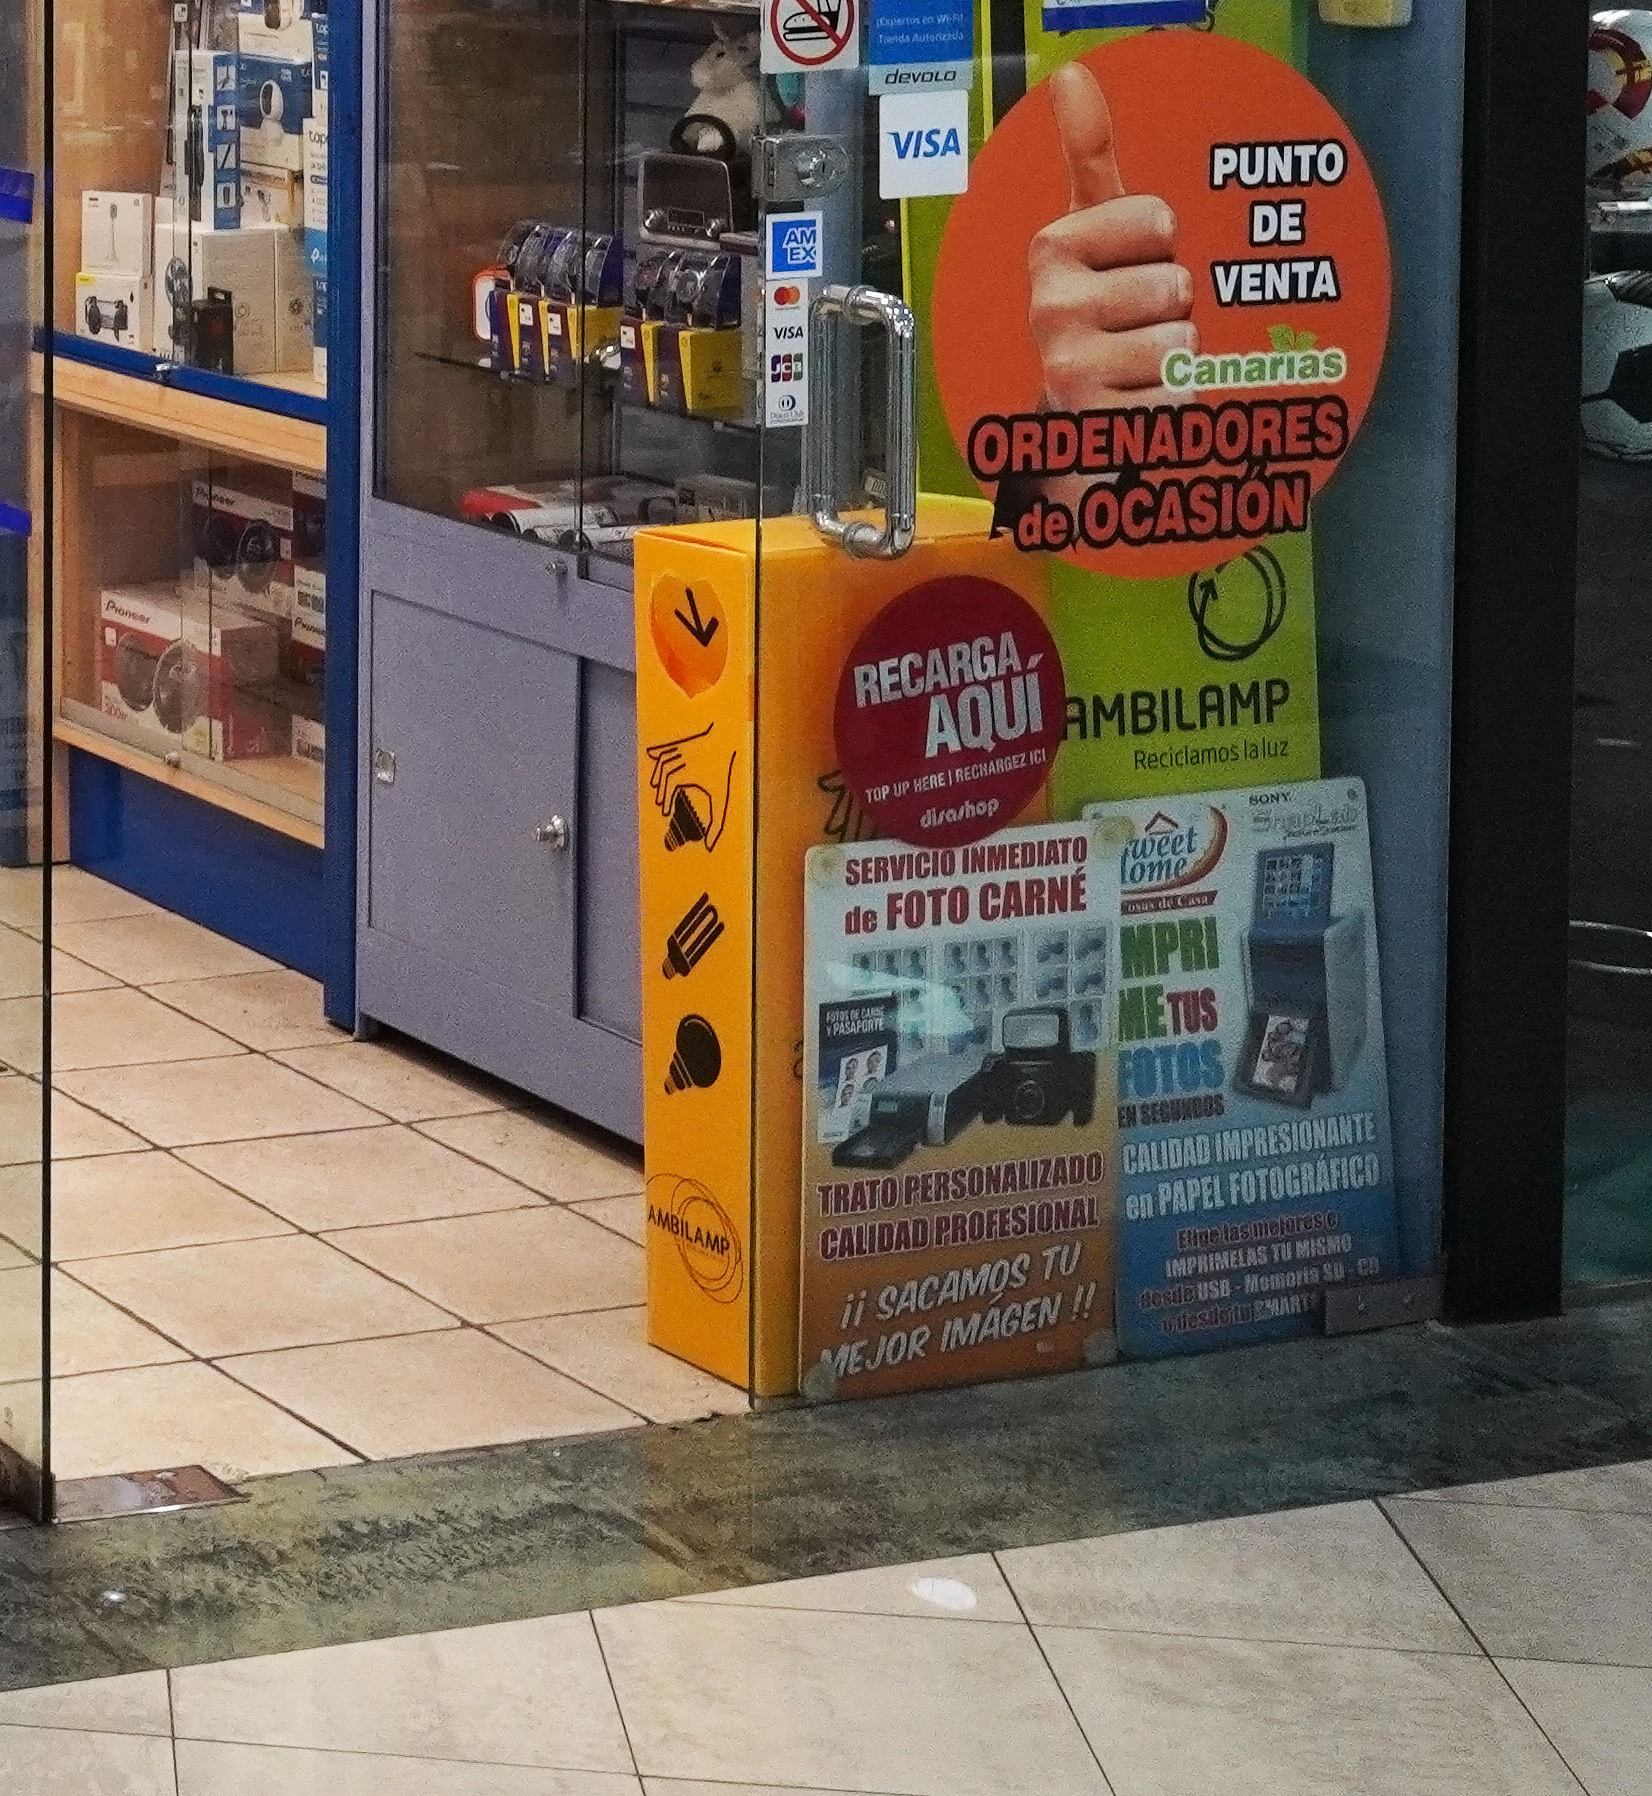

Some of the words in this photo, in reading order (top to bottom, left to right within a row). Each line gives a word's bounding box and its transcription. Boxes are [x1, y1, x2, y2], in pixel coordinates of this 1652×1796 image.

[885, 68, 957, 86] devolo
[889, 129, 960, 159] VISA
[1213, 142, 1345, 185] PUNTO
[1252, 203, 1303, 244] DE
[1214, 261, 1338, 304] VENTA
[1163, 348, 1346, 389] Canarias
[968, 398, 1348, 480] ORDENADORES
[1015, 500, 1075, 552] de
[1075, 463, 1310, 547] OCASIÓN
[854, 632, 1021, 708] RECARGA
[923, 656, 1045, 757] AQUÍ
[1065, 678, 1291, 741] AMBILAMP
[1134, 744, 1236, 771] Reciclamos
[920, 797, 1000, 831] disashop
[845, 853, 956, 887] SERVICIO
[961, 836, 1087, 877] INMEDIATO
[845, 905, 879, 936] de
[886, 881, 971, 929] FOTO
[980, 869, 1087, 920] CARNÉ
[819, 1183, 897, 1215] TRATO
[903, 1152, 1104, 1205] PERSONALIZADO
[646, 1206, 731, 1255] AMBILAMP
[820, 1221, 926, 1261] CALIDAD
[932, 1197, 1098, 1249] PROFESIONAL
[877, 1257, 1034, 1319] SACAMOS
[1039, 1242, 1081, 1282] TU
[819, 1326, 934, 1380] MEJOR
[940, 1290, 1062, 1353] IMÁGEN
